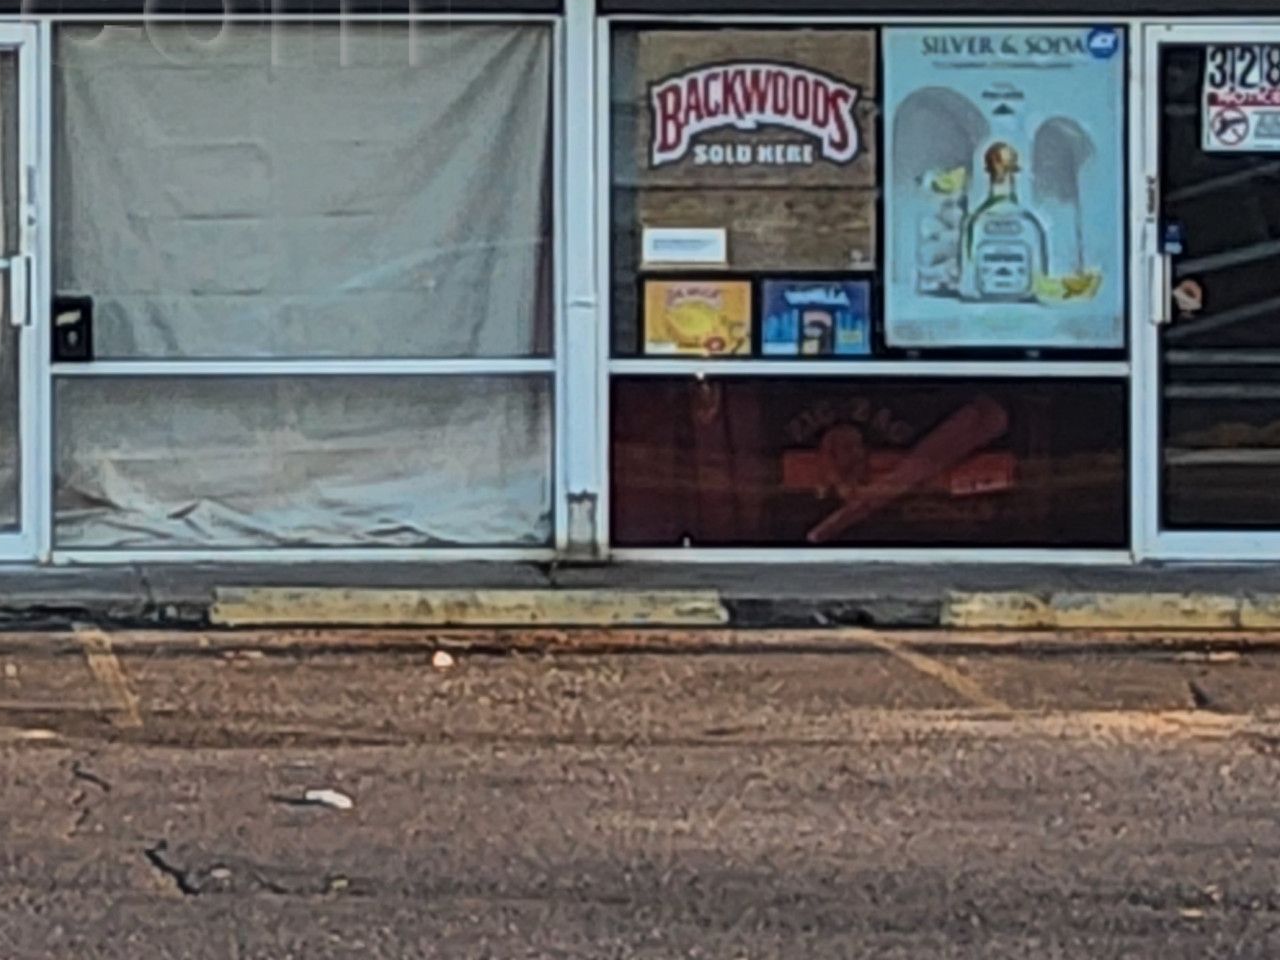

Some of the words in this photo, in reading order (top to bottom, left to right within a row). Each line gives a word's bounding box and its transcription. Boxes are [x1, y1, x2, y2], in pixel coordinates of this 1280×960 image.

[922, 35, 994, 56] SILVER
[1001, 36, 1019, 54] &
[1209, 44, 1280, 90] 328
[656, 68, 851, 153] BACKWOODS
[693, 144, 753, 165] SOLD
[757, 144, 814, 164] HERE
